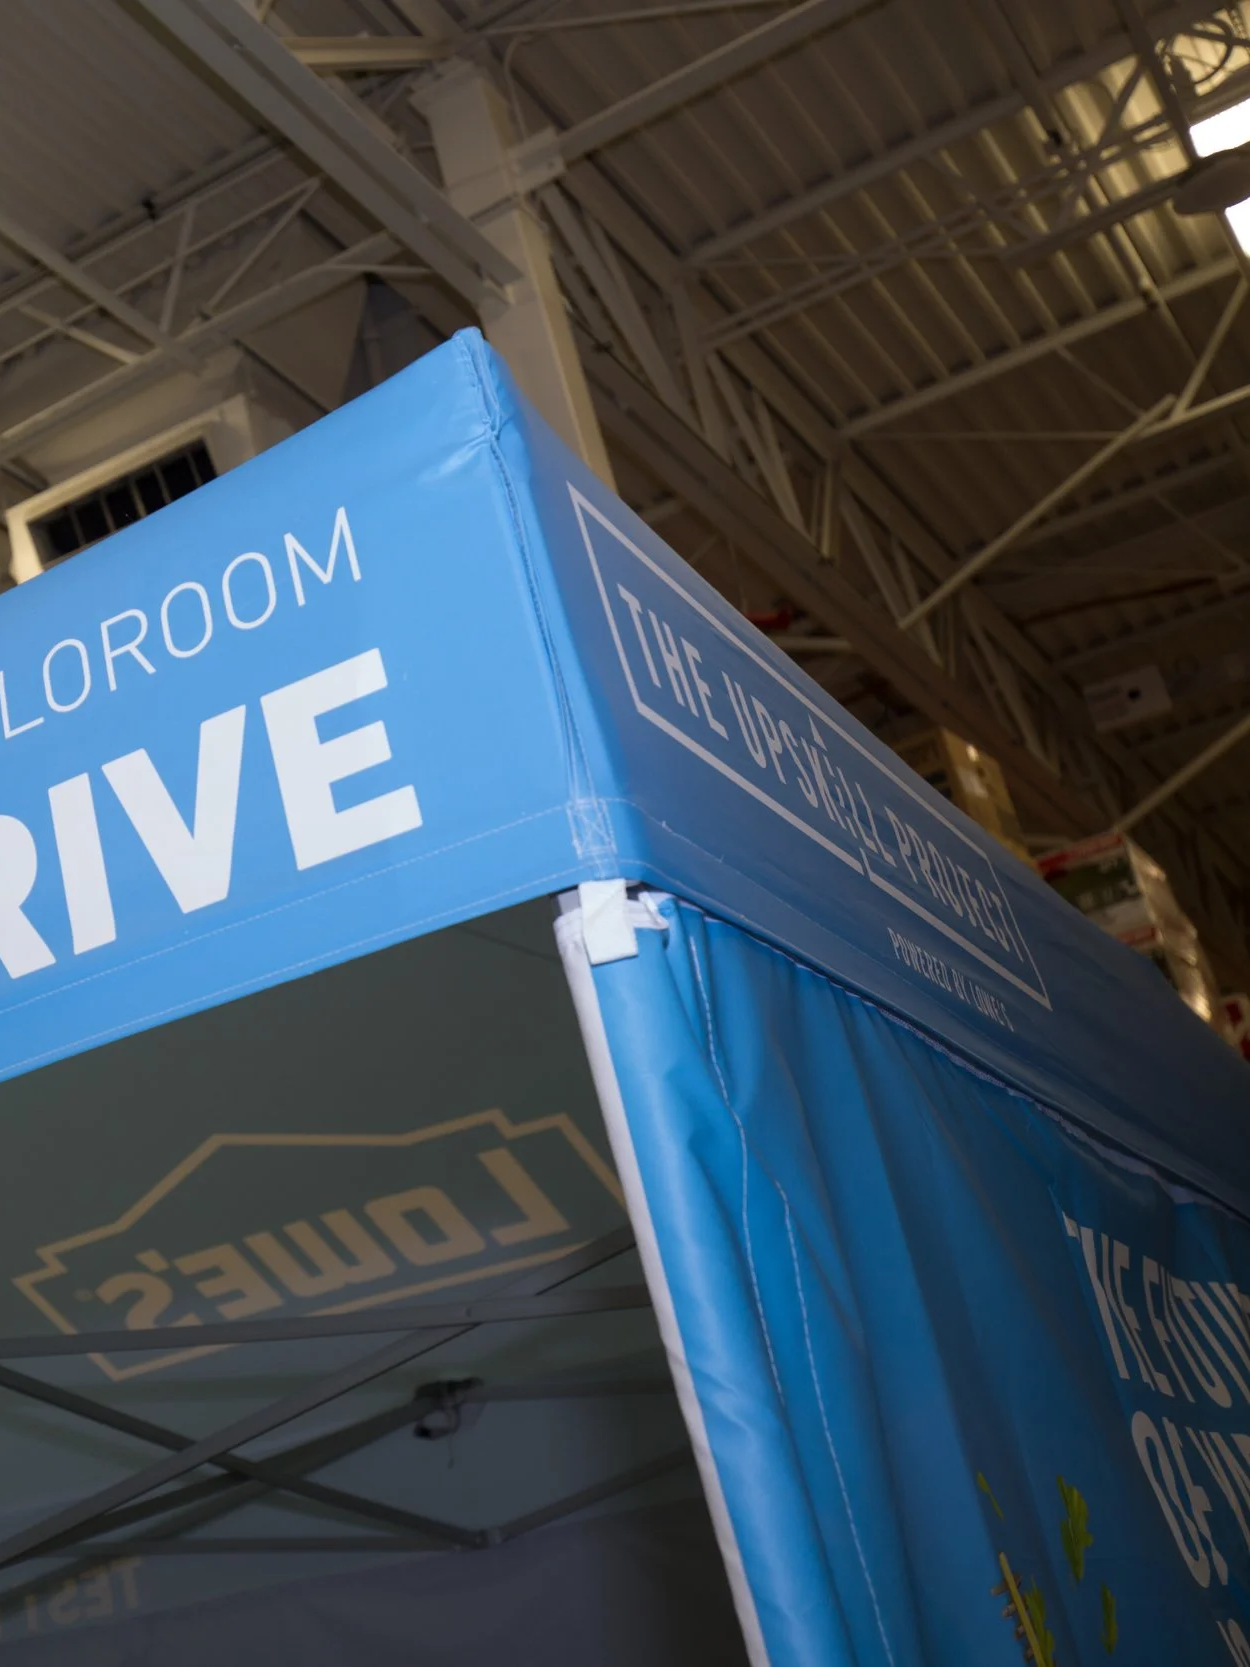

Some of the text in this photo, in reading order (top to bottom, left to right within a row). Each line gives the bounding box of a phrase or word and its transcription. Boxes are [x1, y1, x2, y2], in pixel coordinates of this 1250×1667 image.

[617, 583, 1025, 964] THE UPSKILL PROJECT
[887, 926, 953, 993] POWERED
[951, 968, 971, 1005] BY
[1061, 1210, 1175, 1398] HE
[1130, 1409, 1229, 1589] OF
